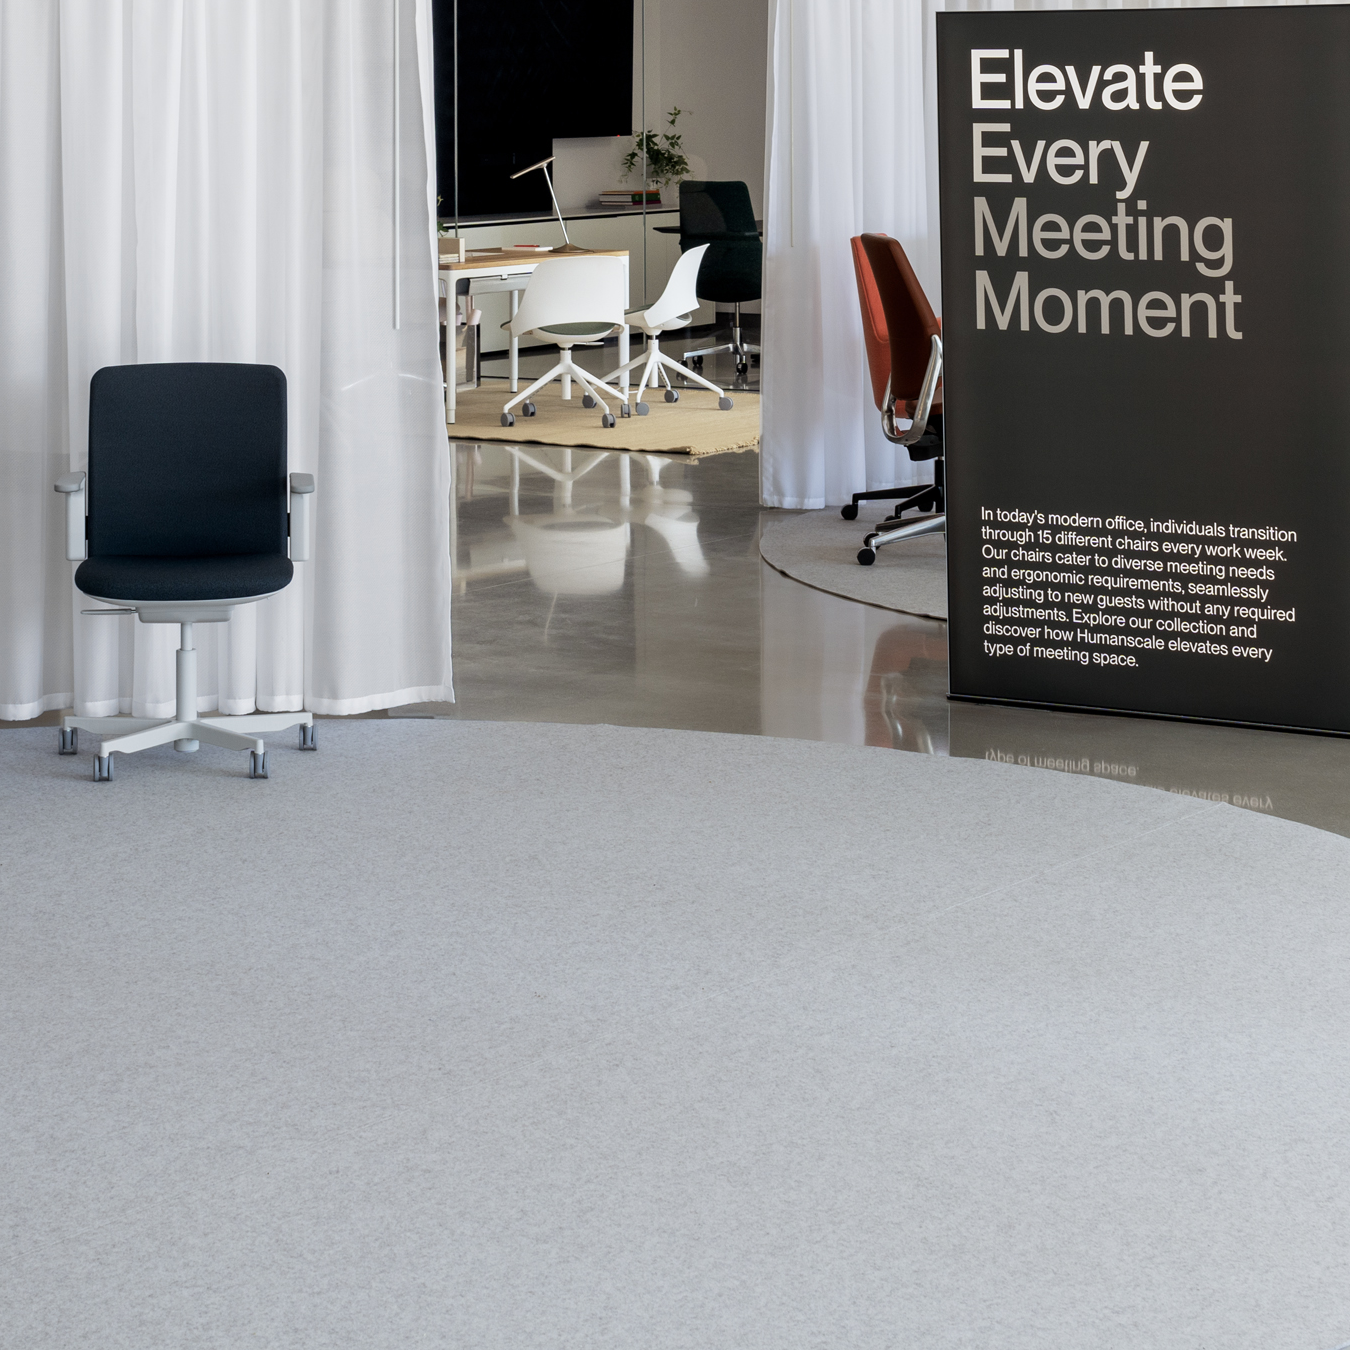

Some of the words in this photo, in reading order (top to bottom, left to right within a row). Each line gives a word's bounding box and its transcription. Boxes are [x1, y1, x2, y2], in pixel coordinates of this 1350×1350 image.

[970, 48, 1204, 111] Elevate
[972, 122, 1150, 200] Every
[973, 196, 1234, 278] Meeting
[975, 269, 1243, 340] Moment
[981, 505, 994, 521] In
[995, 507, 1046, 527] today's
[1048, 512, 1103, 529] modern
[1105, 515, 1148, 534] office,
[1149, 517, 1227, 538] individuals
[1228, 523, 1297, 543] transition
[981, 525, 1035, 545] through
[1036, 529, 1053, 545] 15
[1055, 530, 1113, 549] different
[1115, 535, 1160, 553] chairs
[1161, 541, 1203, 559] every
[1204, 543, 1242, 559] work
[1243, 545, 1288, 562] week.
[981, 543, 1009, 560] Our
[1010, 546, 1053, 563] chairs
[1055, 551, 1092, 567] cater
[1093, 553, 1109, 568] to
[1111, 554, 1164, 572] diverse
[1167, 560, 1226, 580] meeting
[1229, 565, 1276, 581] needs
[981, 564, 1008, 579] and
[1010, 568, 1085, 585] ergonomic
[1087, 573, 1185, 595] requirements,
[1187, 582, 1269, 603] seamlessly
[982, 583, 1045, 604] adjusting
[1046, 587, 1062, 603] to
[1064, 591, 1095, 605] new
[1096, 594, 1146, 610] guests
[1147, 596, 1202, 615] without
[1204, 603, 1231, 620] any
[1233, 605, 1296, 623] required
[982, 601, 1070, 623] adjustments.
[1072, 608, 1126, 628] Explore
[1128, 616, 1154, 630] our
[1155, 617, 1226, 636] collection
[1229, 623, 1257, 639] and
[983, 620, 1042, 639] discover
[1044, 625, 1075, 642] how
[1077, 627, 1165, 651] Humanscale
[1167, 636, 1229, 656] elevates
[1231, 645, 1273, 663] every
[983, 639, 1015, 657] type
[1016, 642, 1031, 657] of
[1033, 646, 1089, 666] meeting
[1092, 652, 1139, 667] space.
